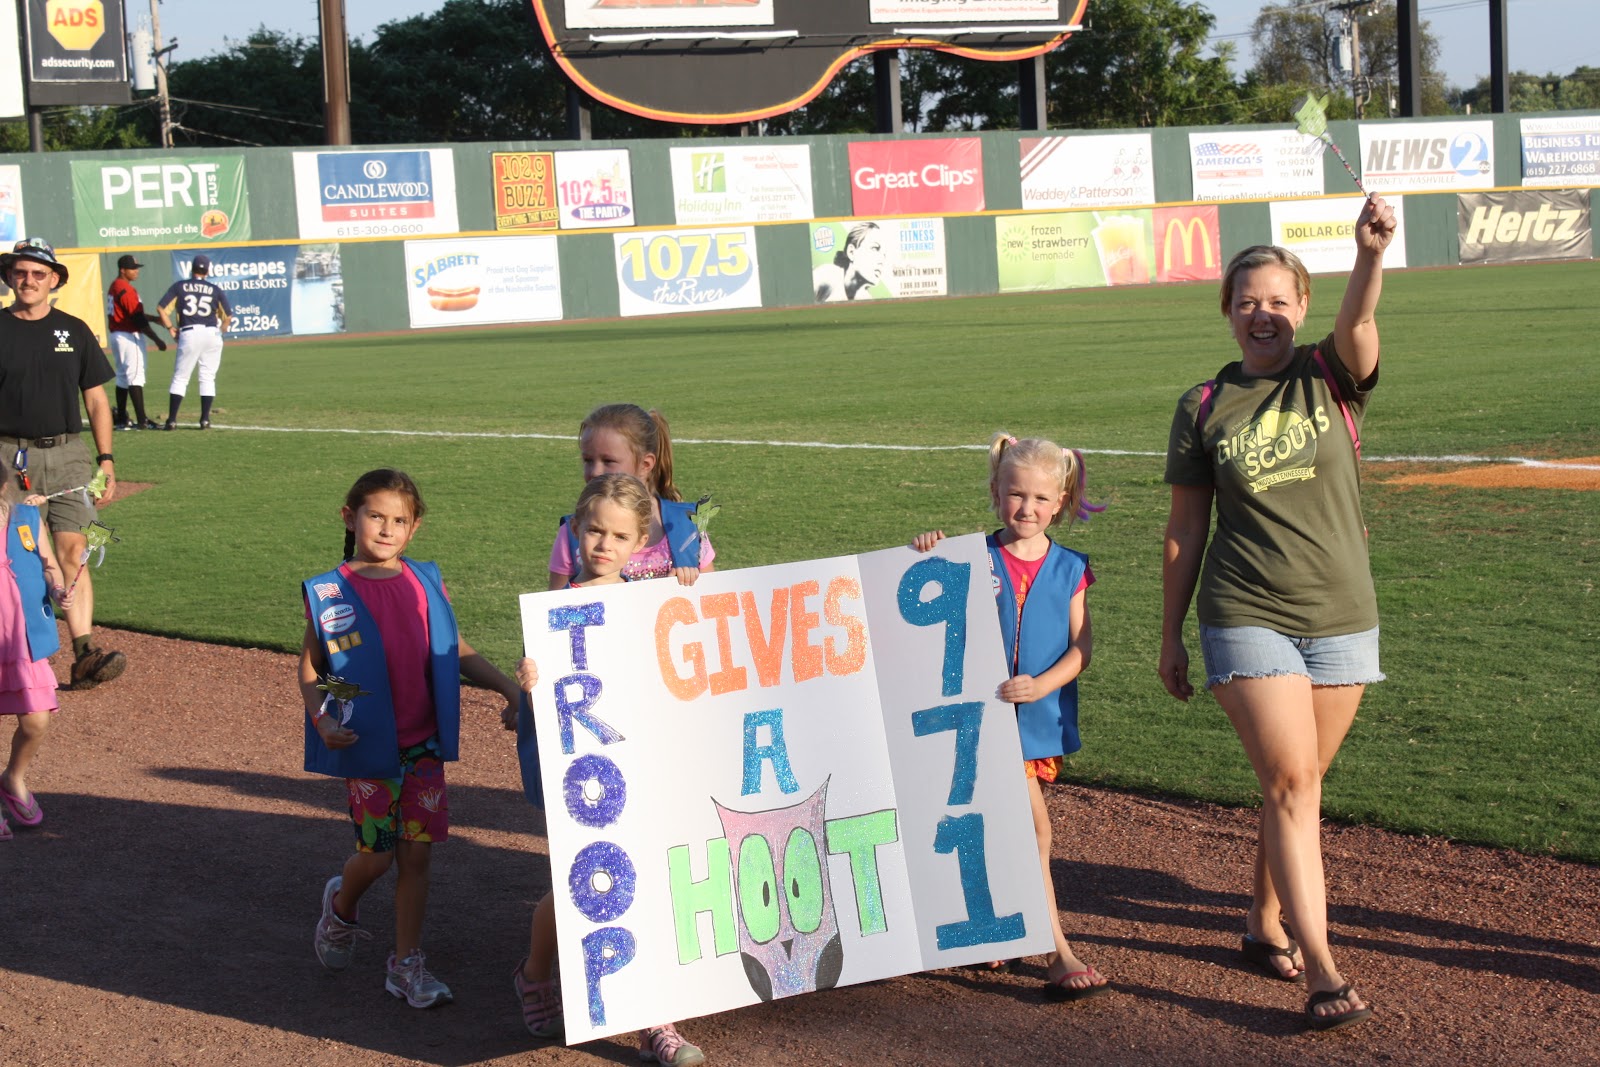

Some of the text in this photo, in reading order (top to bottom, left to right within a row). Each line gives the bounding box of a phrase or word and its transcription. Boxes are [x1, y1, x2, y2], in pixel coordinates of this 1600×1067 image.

[53, 8, 98, 27] ADS
[41, 58, 115, 69] adssecurity.com
[1525, 137, 1581, 148] BUSINESS
[1366, 133, 1483, 171] NEWS 2
[1525, 151, 1600, 163] WAREHOUSE
[501, 156, 546, 181] 102.9
[1196, 156, 1263, 166] AMERICA'S
[1289, 158, 1315, 166] 90210
[1292, 168, 1314, 177] WIN
[1526, 163, 1596, 176] (615) 227-6868
[855, 164, 975, 192] Great Clips
[1409, 175, 1457, 184] NASHVILLE
[101, 164, 217, 210] PERT
[208, 174, 219, 205] PLUS
[324, 182, 429, 200] CANDLEWOOD
[560, 179, 613, 206] 102.5
[504, 185, 547, 207] BUZZ
[1196, 190, 1321, 201] AmericasMotorSports.com
[350, 207, 408, 218] SUITES
[578, 207, 595, 219] THE
[678, 197, 743, 215] Holiday Inn
[337, 224, 424, 236] 615-309-0600
[1031, 225, 1062, 236] frozen
[1466, 203, 1582, 244] Hertz
[100, 225, 198, 238] Official Shampoo of the
[900, 229, 935, 242] FITNESS
[1286, 226, 1333, 239] DOLLAR
[1007, 240, 1023, 249] new
[1032, 237, 1089, 250] strawberry
[620, 232, 750, 281] 107.5
[1032, 250, 1075, 261] lemonade
[180, 260, 286, 280] Wterscapes
[414, 253, 480, 288] SABRETT
[182, 283, 214, 295] CASTRO
[243, 278, 288, 290] RESORTS
[182, 294, 214, 317] 35
[235, 304, 260, 315] Seelig
[1217, 423, 1272, 465] GIRL
[1244, 406, 1330, 477] SCOUTS
[1256, 469, 1309, 490] MIDDLE TENNESSEE
[323, 612, 334, 621] Girl
[654, 574, 868, 701] GIVES
[741, 708, 800, 796] A
[897, 556, 1026, 951] 971
[548, 601, 637, 1029] TROOP
[666, 808, 899, 965] HOOT
